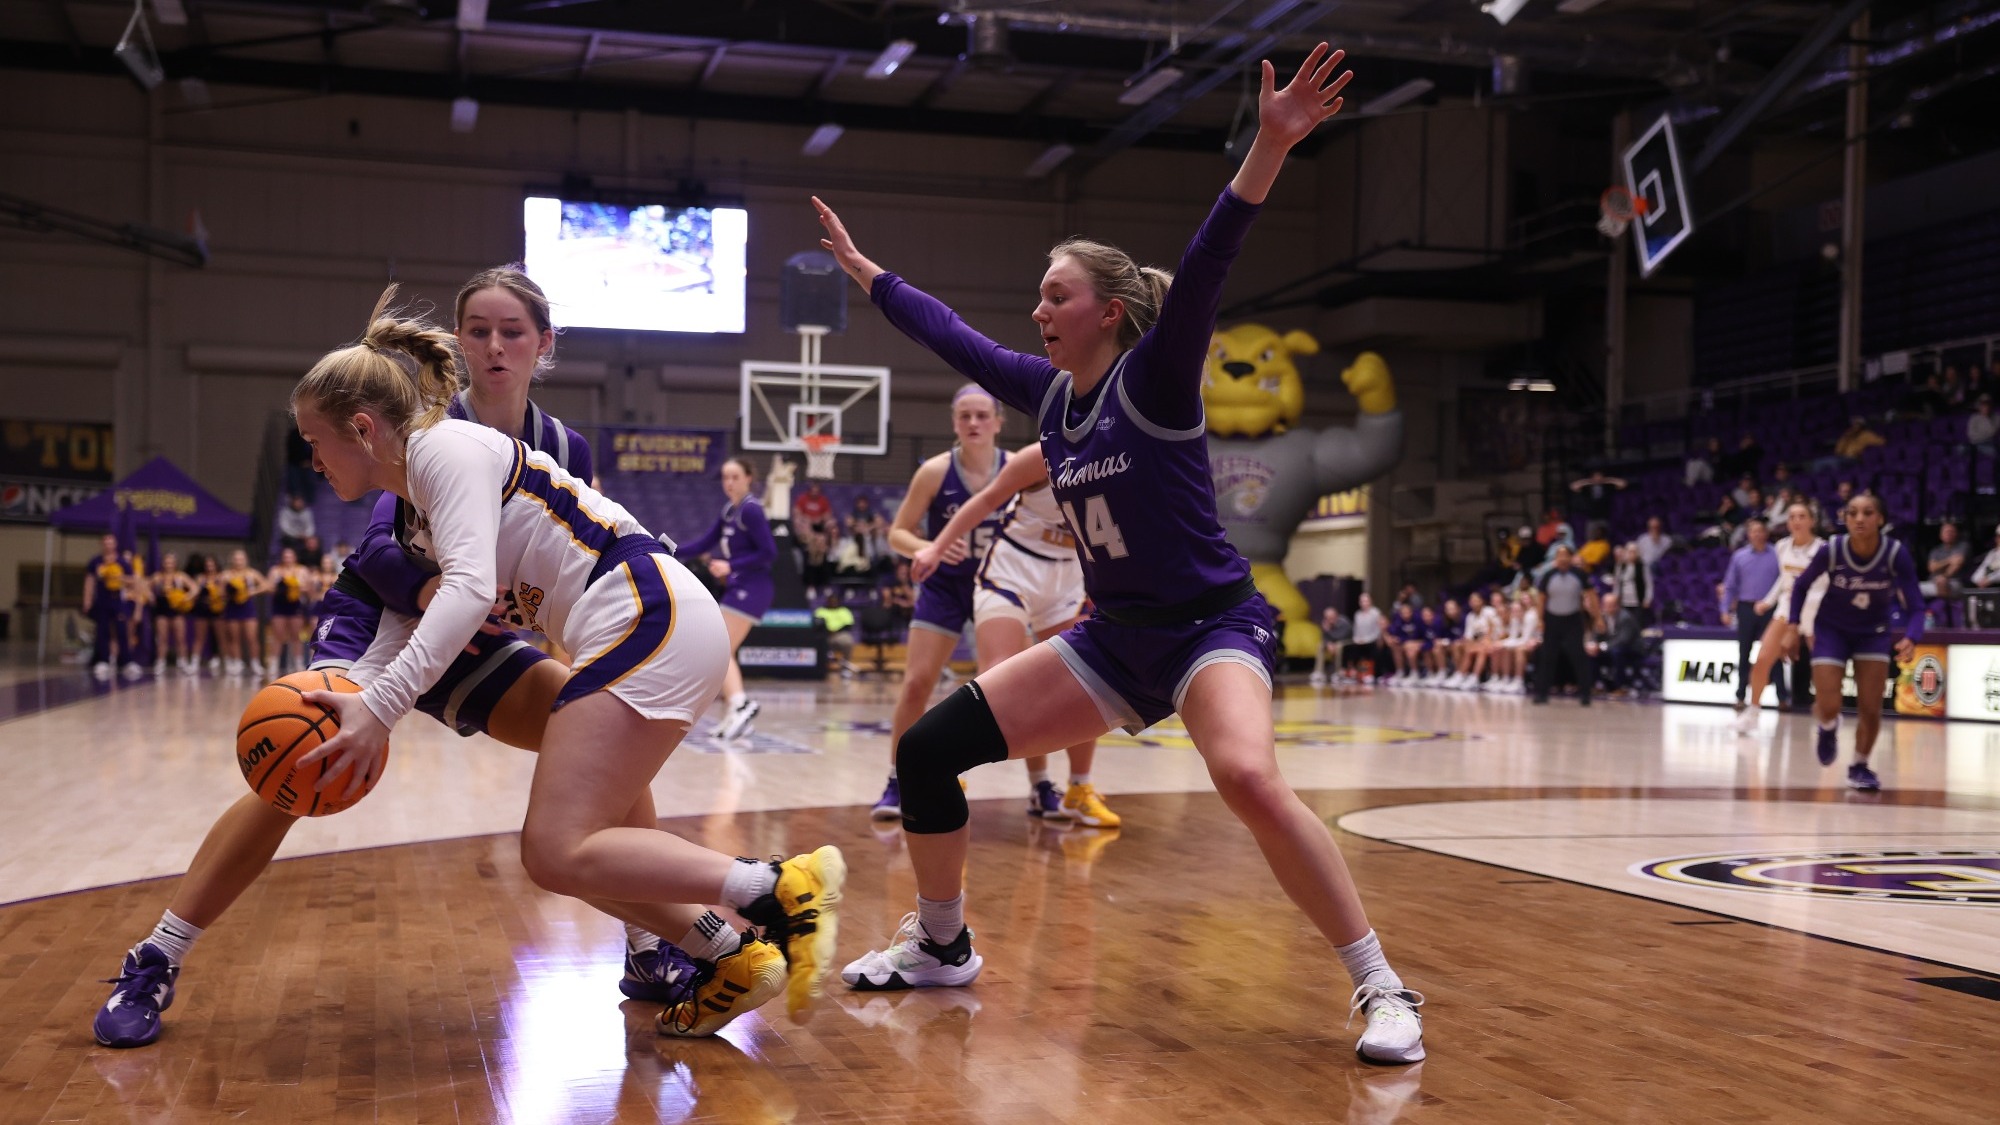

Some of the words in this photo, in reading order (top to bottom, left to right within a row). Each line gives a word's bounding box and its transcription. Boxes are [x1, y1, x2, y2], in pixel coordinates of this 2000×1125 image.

[613, 433, 711, 453] STUDENT
[618, 453, 705, 472] SECTION
[1057, 451, 1132, 490] Thomas
[1060, 493, 1130, 563] 14
[1851, 591, 1871, 611] 4
[1679, 660, 1737, 684] MAR
